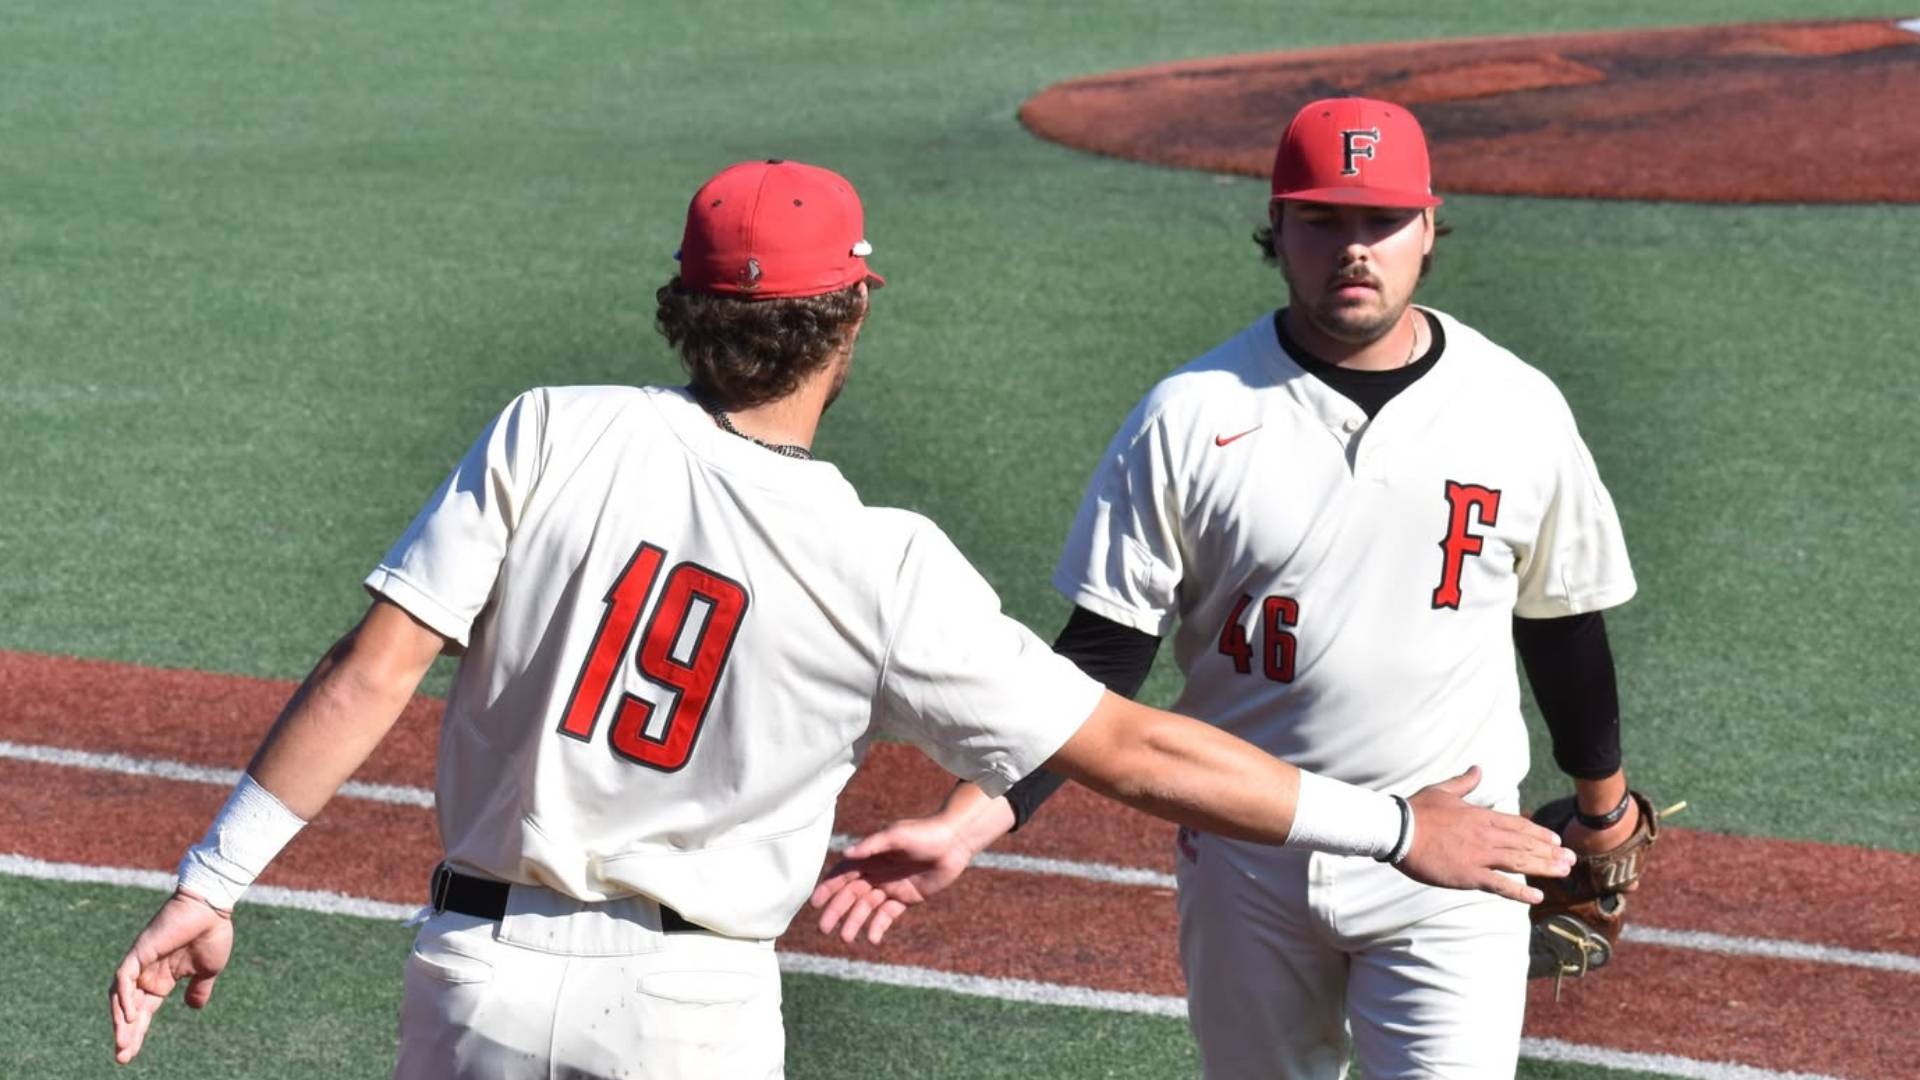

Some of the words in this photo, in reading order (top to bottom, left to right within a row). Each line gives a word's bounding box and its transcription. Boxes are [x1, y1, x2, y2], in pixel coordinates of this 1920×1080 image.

[1340, 126, 1380, 176] F
[1432, 480, 1501, 610] F
[556, 540, 750, 774] 19
[1218, 593, 1299, 684] 46
